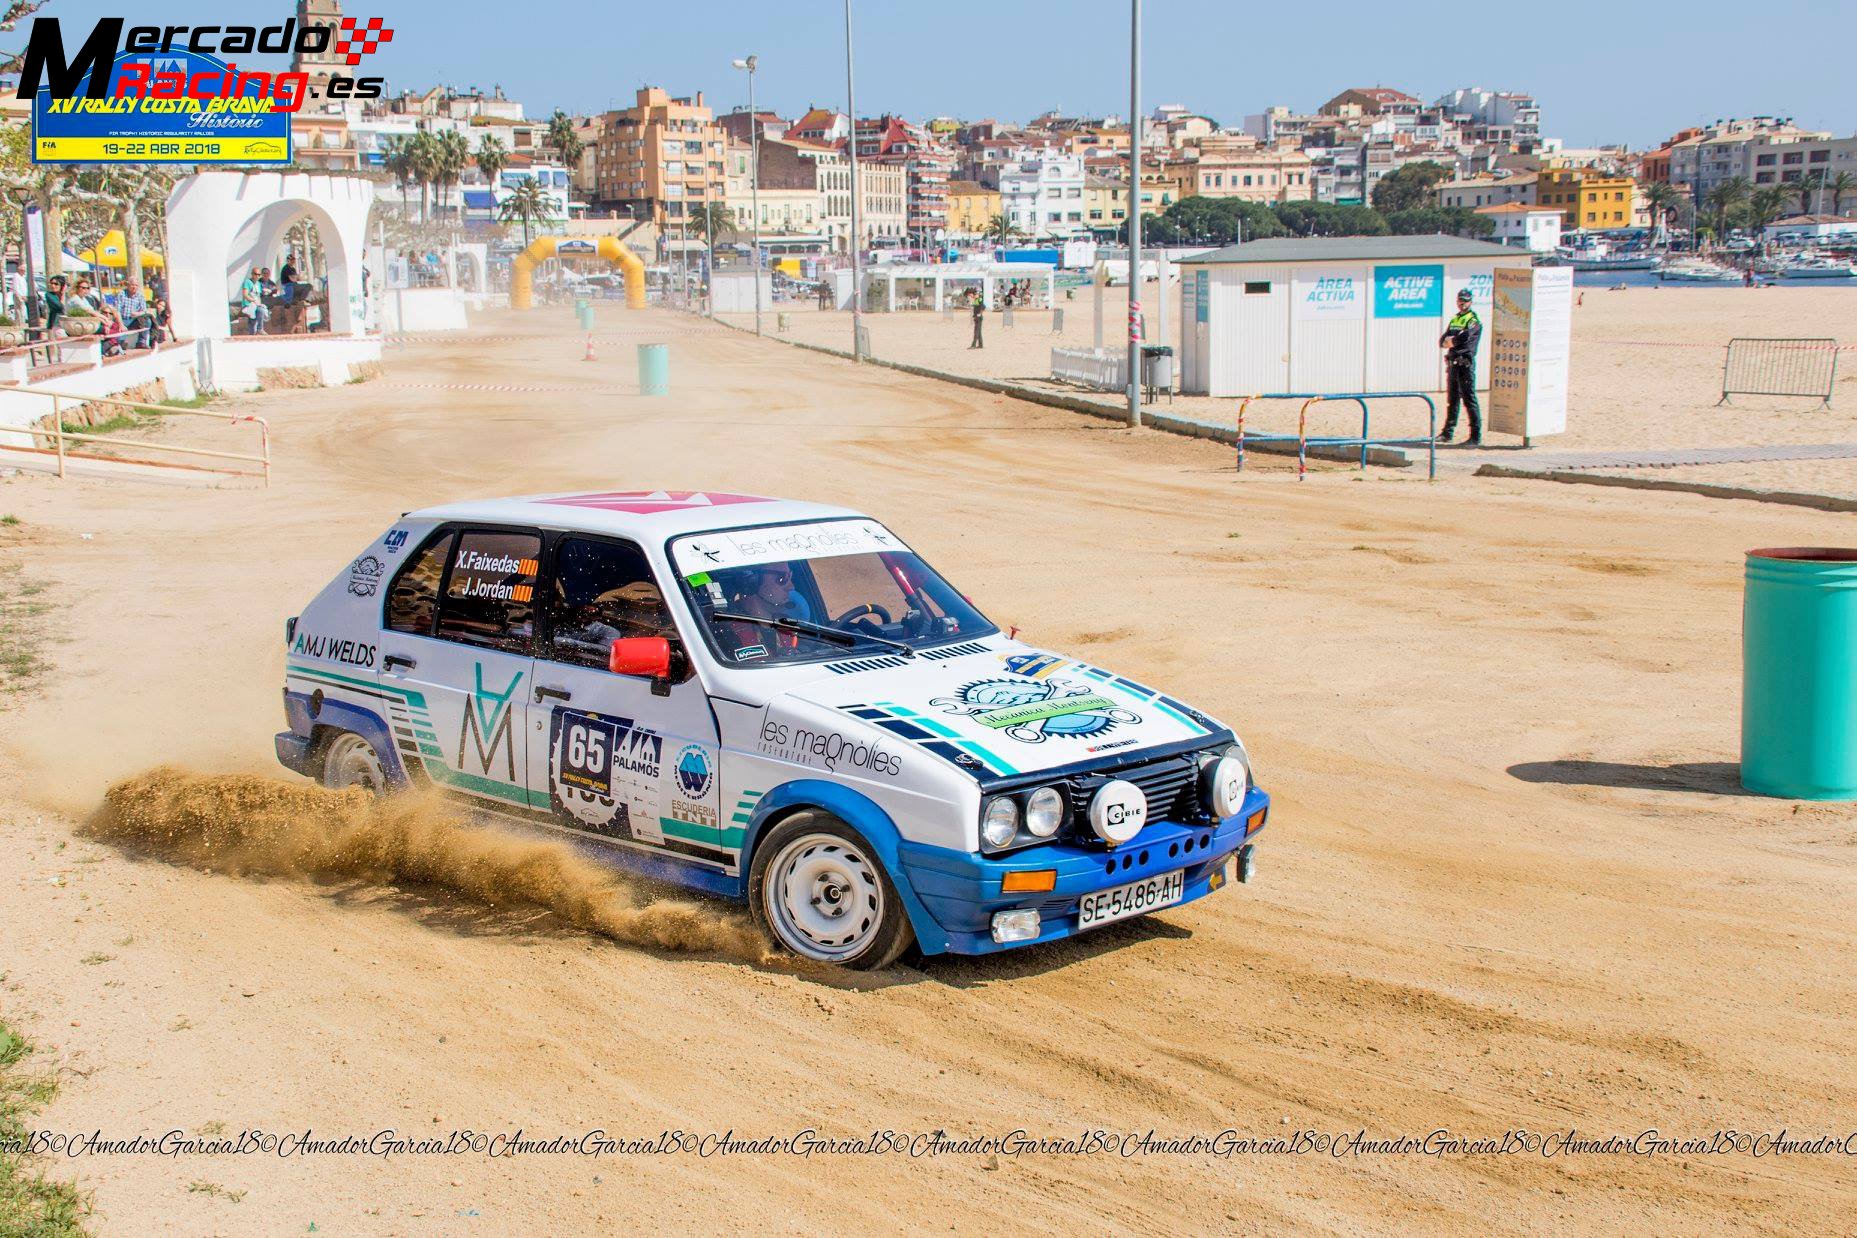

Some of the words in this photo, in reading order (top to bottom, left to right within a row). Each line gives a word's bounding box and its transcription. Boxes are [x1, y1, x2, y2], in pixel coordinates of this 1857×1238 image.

[1383, 276, 1434, 289] ACTIVE
[1306, 290, 1355, 302] ACTIVA
[455, 550, 520, 574] X.Faixedas
[462, 577, 514, 600] J.Jordan
[294, 632, 328, 658] AMJ
[328, 637, 377, 668] WELDS
[760, 702, 789, 745] les
[568, 724, 606, 774] 65
[672, 800, 717, 816] ESCUDERIA
